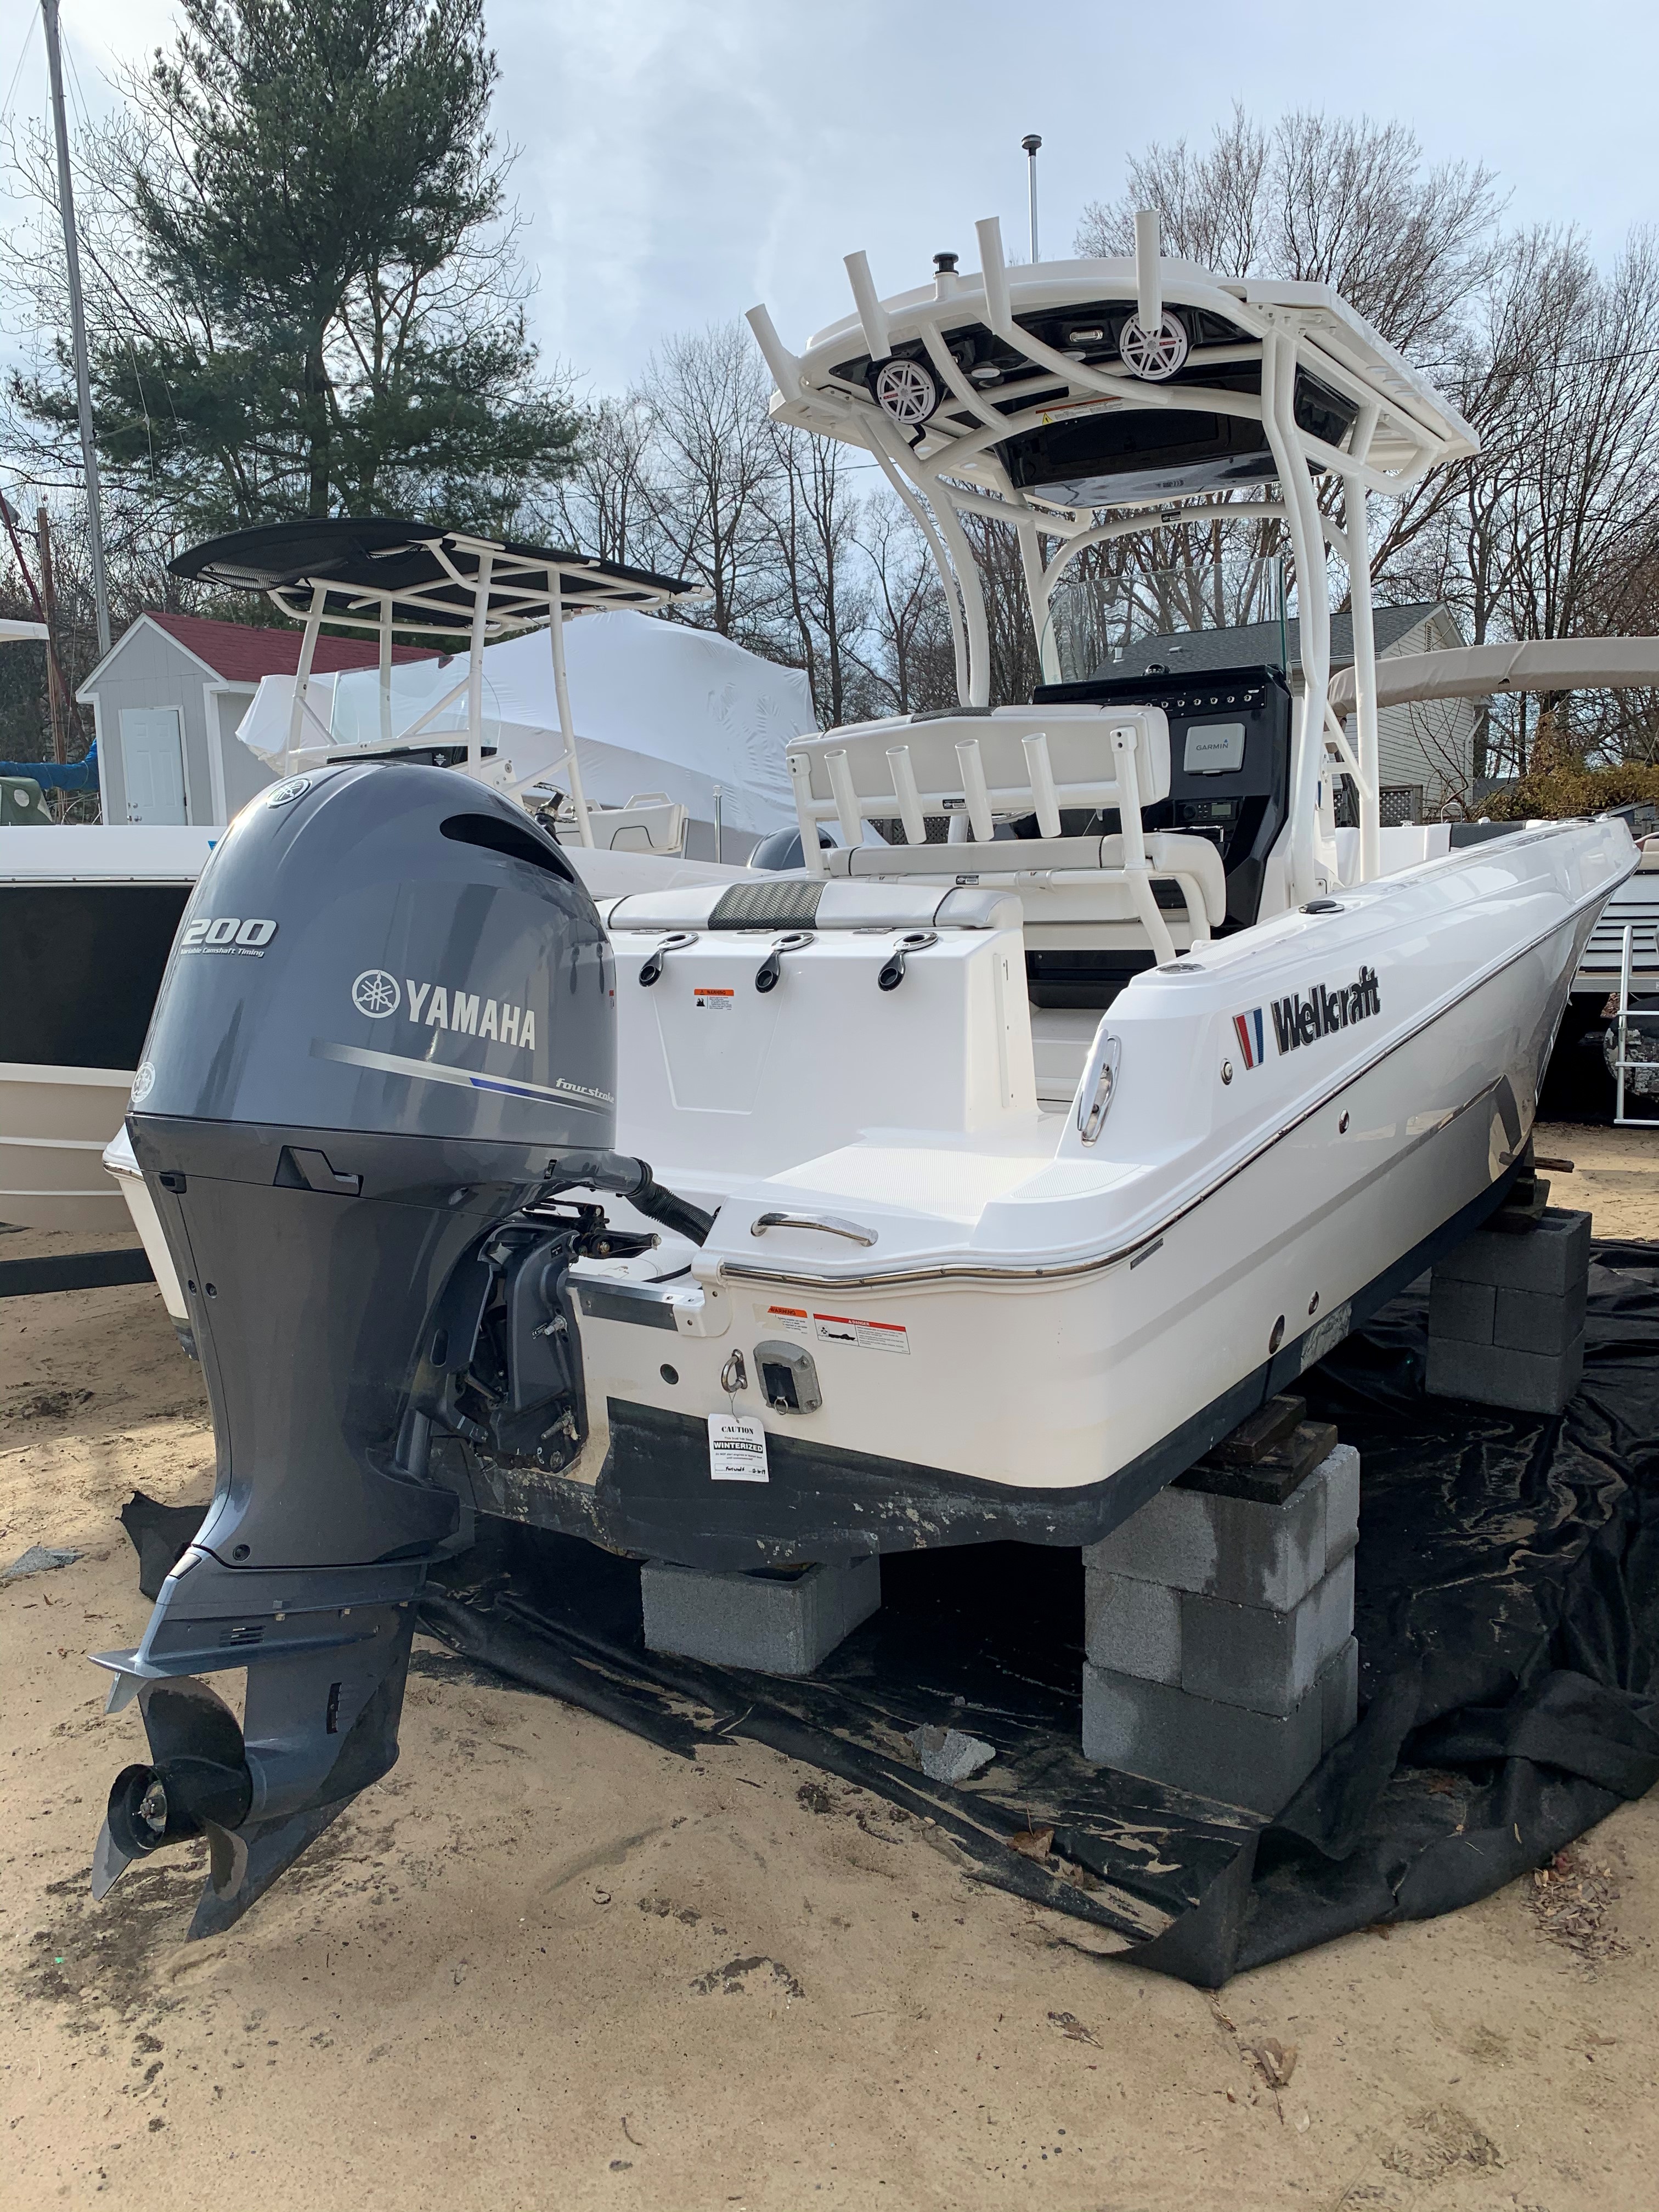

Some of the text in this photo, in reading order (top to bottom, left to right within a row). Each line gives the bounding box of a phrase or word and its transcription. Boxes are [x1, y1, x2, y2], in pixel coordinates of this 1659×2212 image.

[182, 918, 277, 946] 200
[238, 947, 265, 957] Timing
[406, 979, 535, 1051] YAMAHA
[1270, 964, 1381, 1056] Wellcraft
[556, 1077, 615, 1104] fourstroke
[770, 1307, 796, 1316] WARNING
[721, 1426, 754, 1435] CAUTION
[714, 1442, 763, 1452] WINTERIZED
